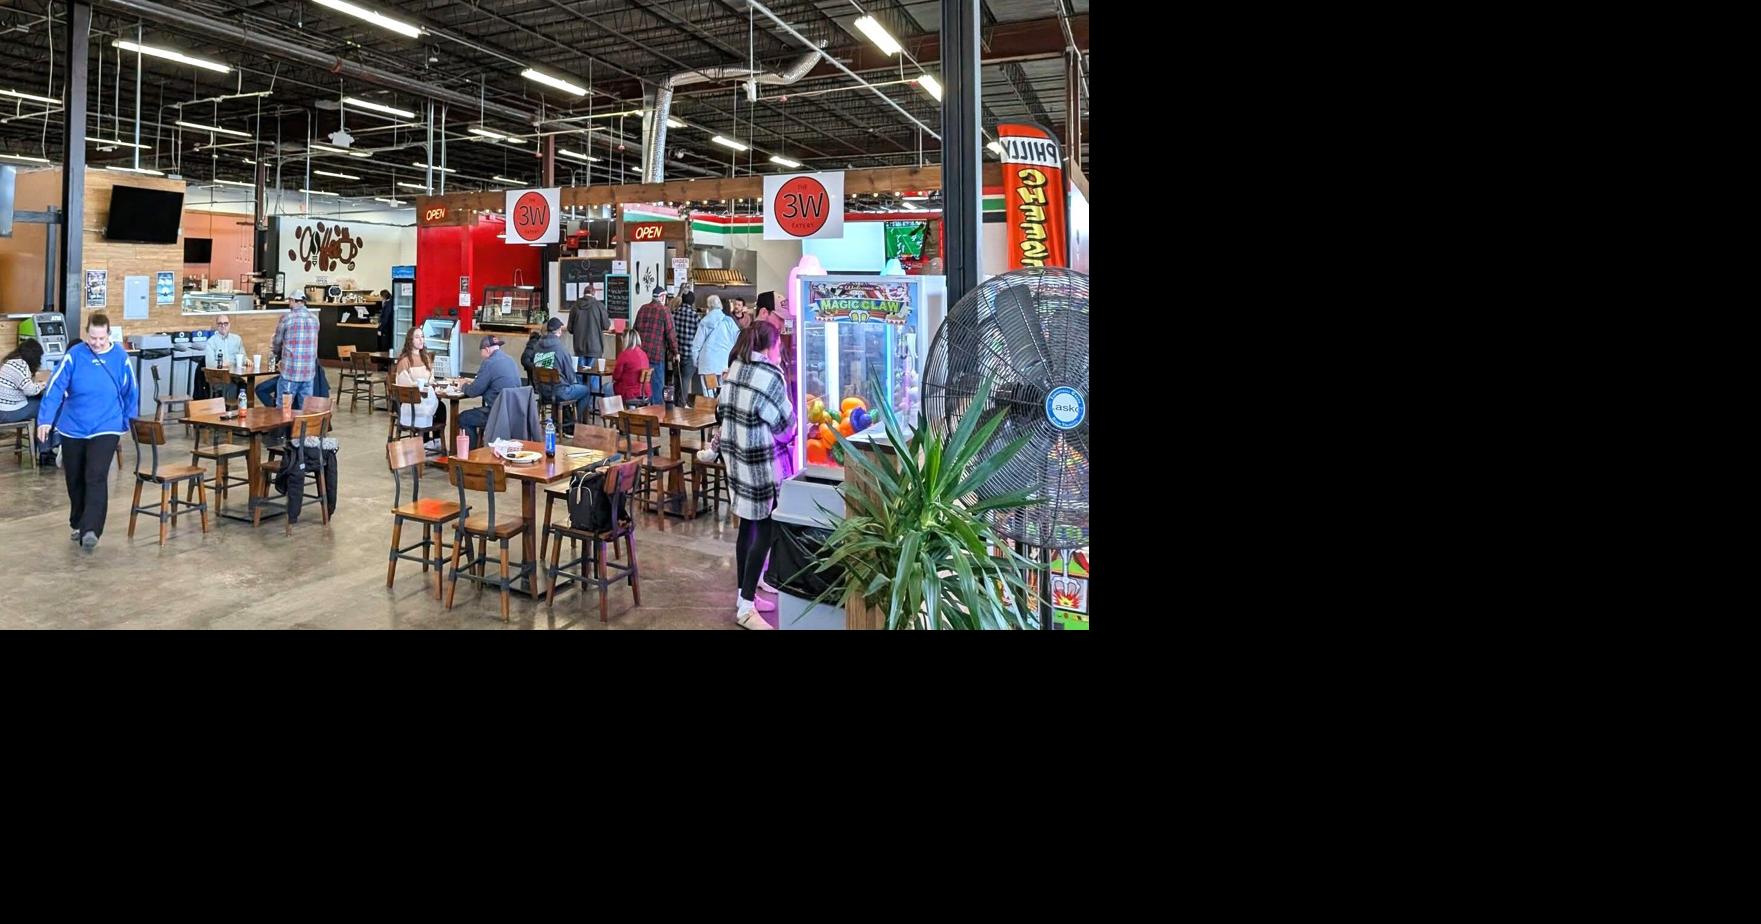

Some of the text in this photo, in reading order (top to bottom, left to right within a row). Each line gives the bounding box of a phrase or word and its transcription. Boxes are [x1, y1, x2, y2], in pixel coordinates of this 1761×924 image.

[782, 192, 823, 218] 3W
[426, 208, 446, 221] OPEN
[519, 205, 546, 226] 3W
[635, 226, 663, 239] OPEN
[821, 299, 899, 312] MAGIC CLAW
